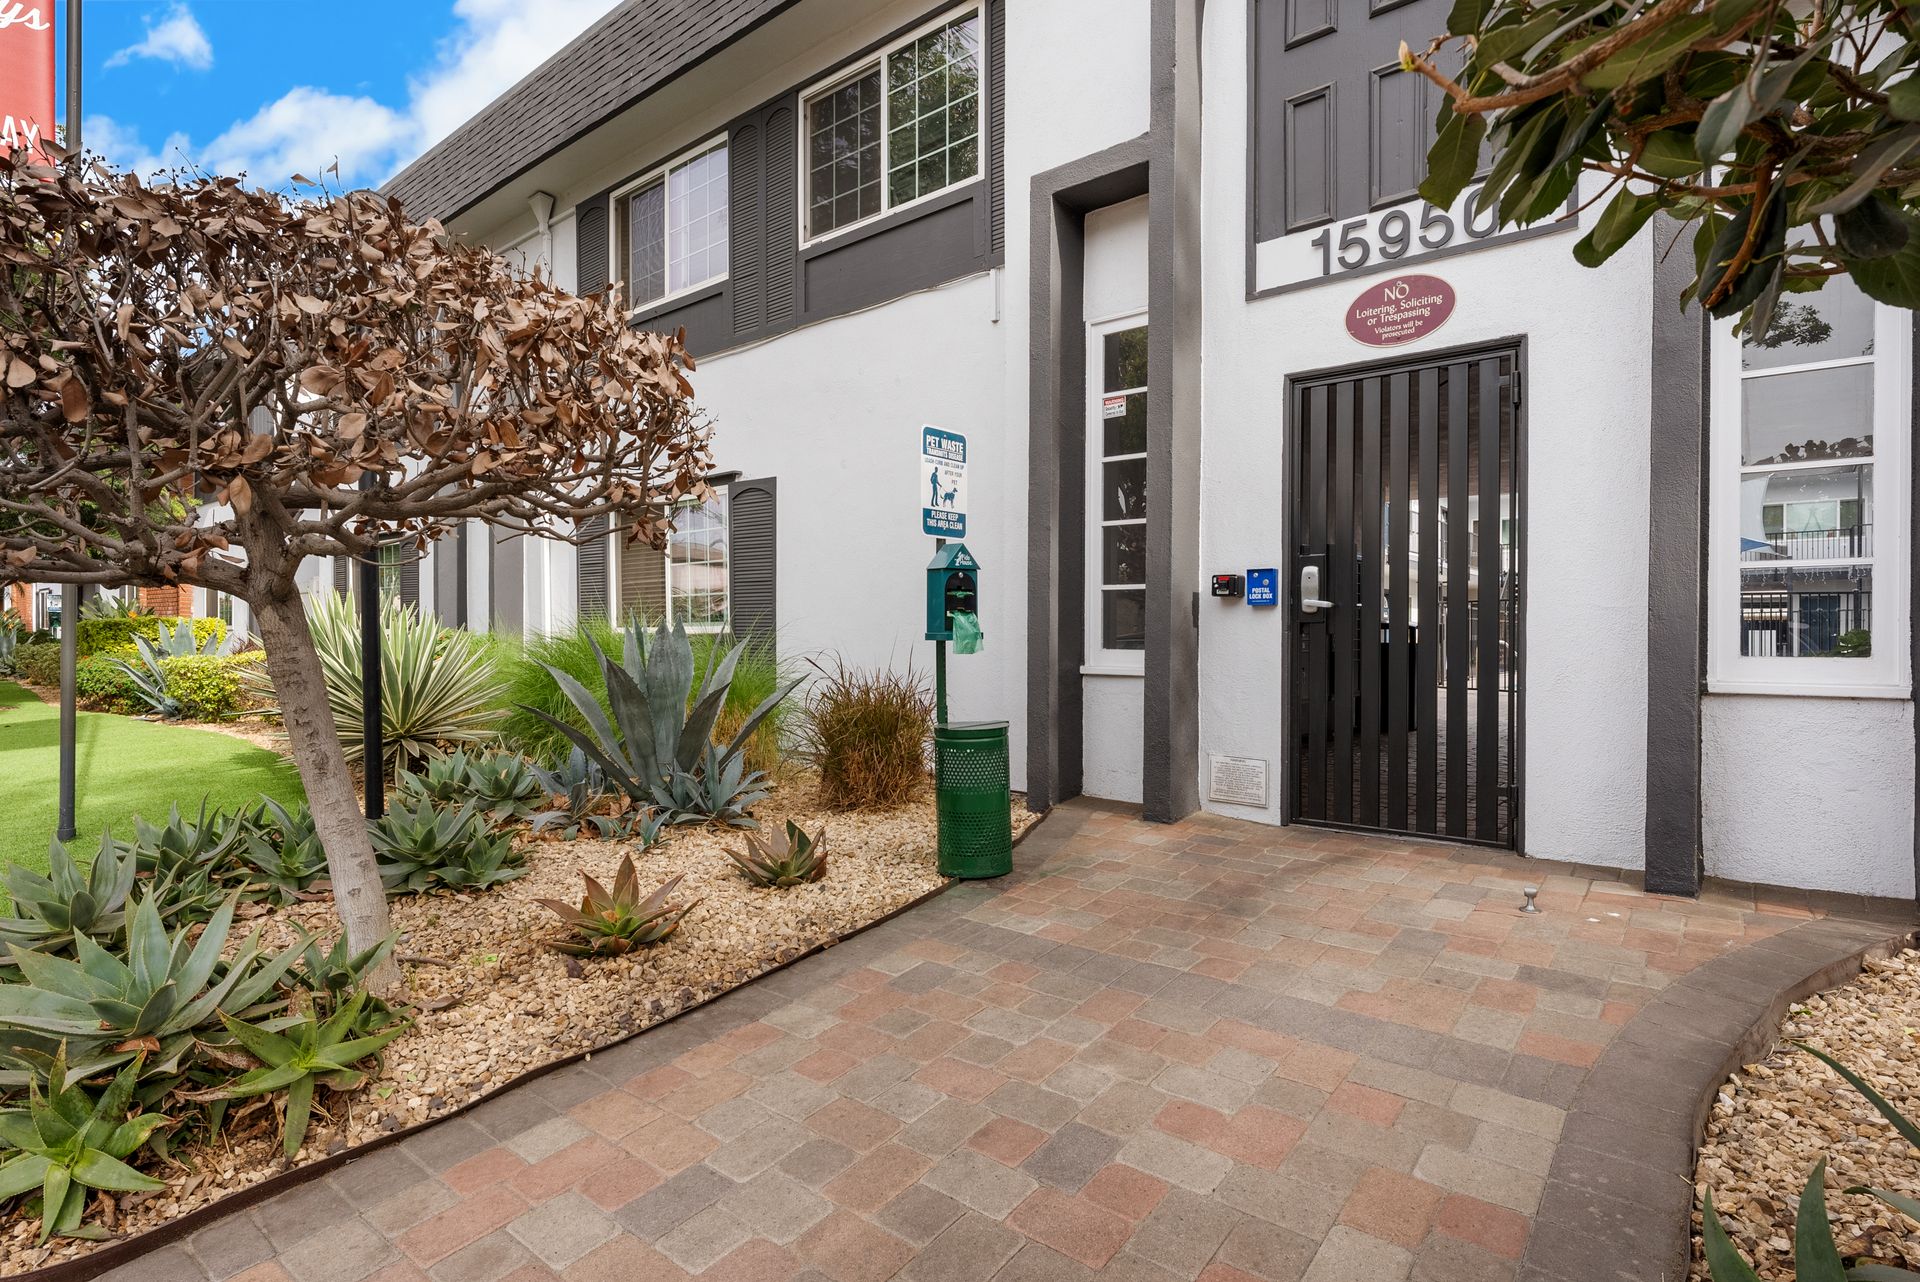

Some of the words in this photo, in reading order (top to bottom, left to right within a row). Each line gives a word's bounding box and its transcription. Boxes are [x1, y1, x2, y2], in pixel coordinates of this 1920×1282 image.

[1311, 187, 1500, 275] 15950
[1384, 282, 1410, 302] NO
[1400, 294, 1443, 310] Soliciting
[1367, 317, 1377, 326] or
[1380, 306, 1431, 323] Trespassing
[1374, 325, 1402, 334] Violators
[1402, 319, 1414, 329] will
[1381, 327, 1415, 340] prosecuted
[926, 434, 940, 449] PET
[941, 438, 964, 453] WASTE
[926, 518, 937, 527] THIS
[937, 520, 948, 529] AREA
[949, 521, 963, 530] CLEAN
[931, 510, 947, 520] PLEASE
[947, 513, 959, 522] KEEP
